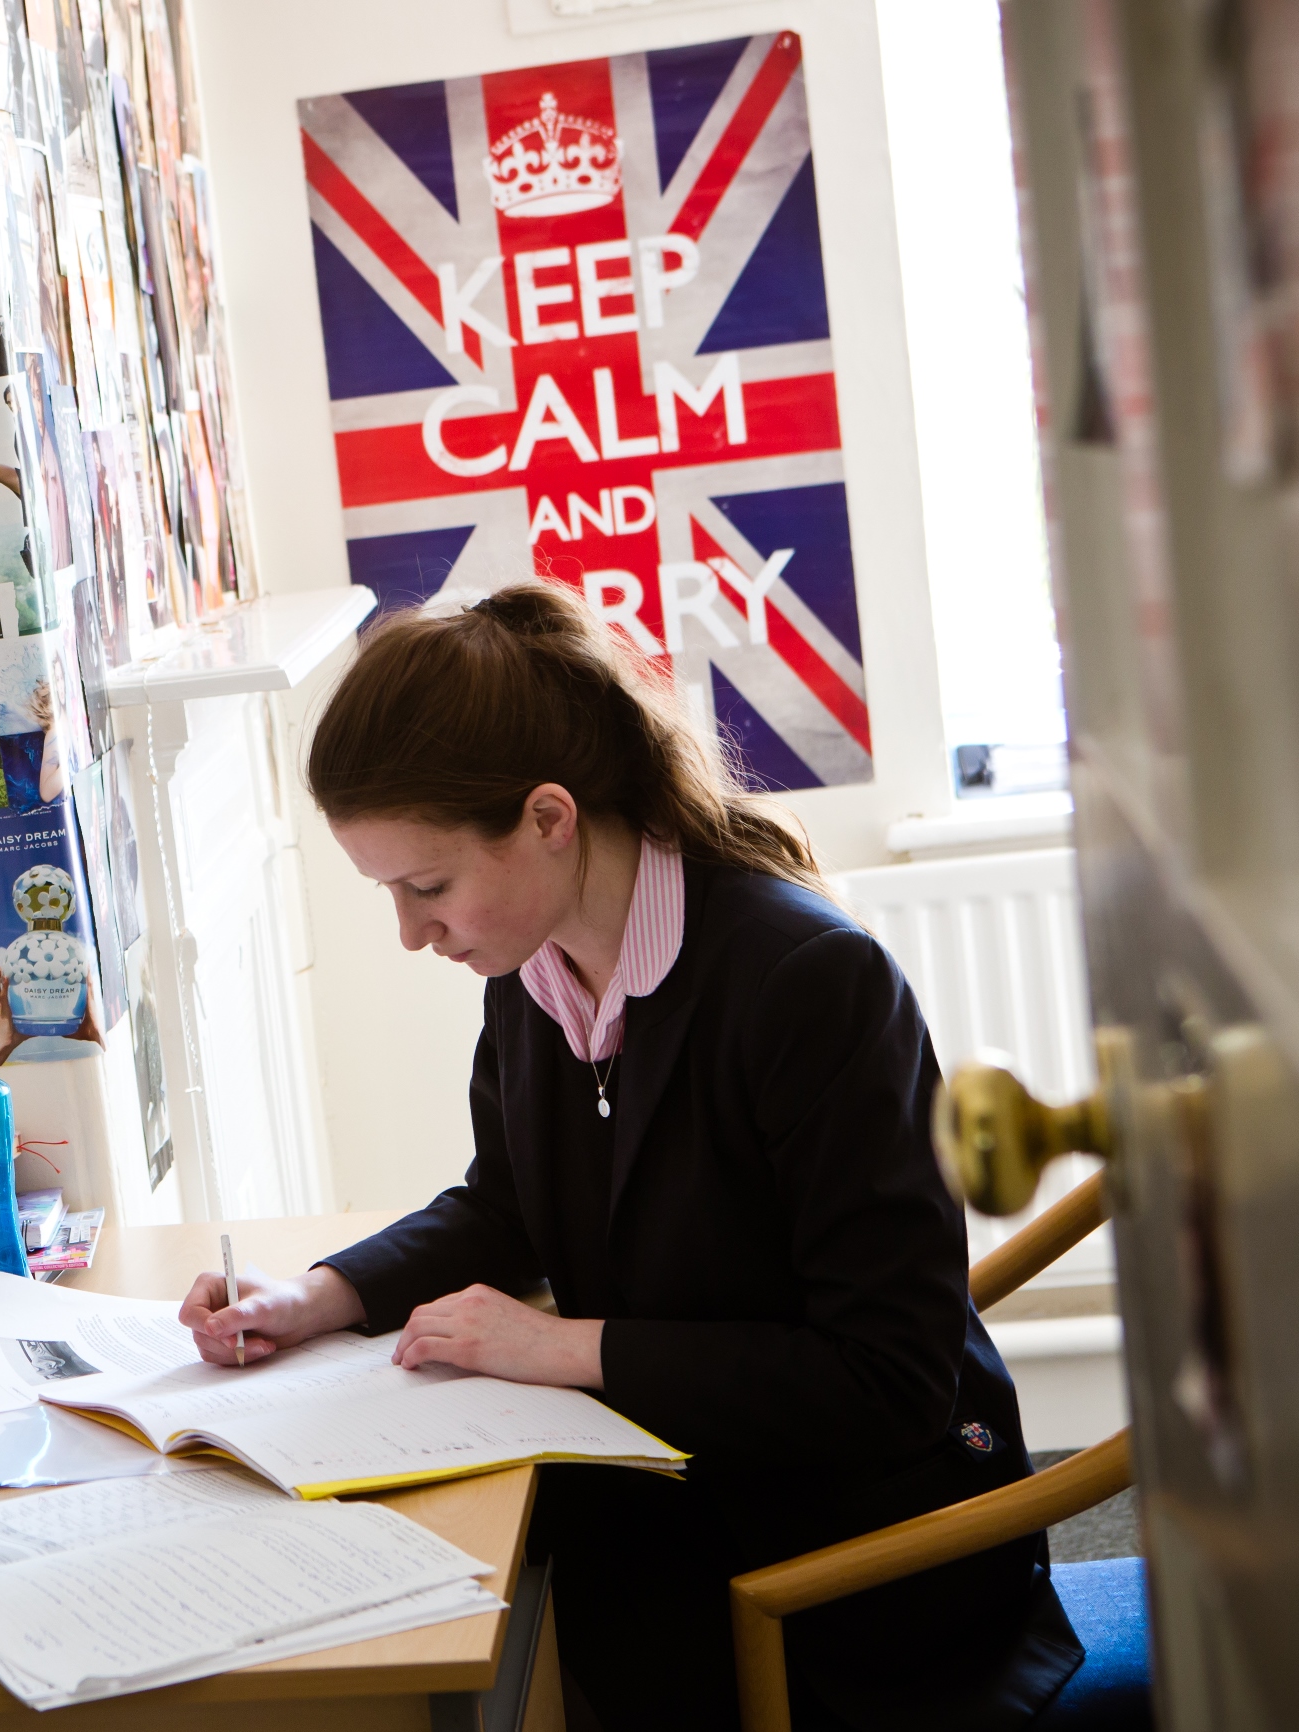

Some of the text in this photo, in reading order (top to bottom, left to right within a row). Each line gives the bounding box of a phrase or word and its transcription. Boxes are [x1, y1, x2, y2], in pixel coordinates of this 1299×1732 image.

[436, 232, 699, 355] KEEP
[421, 353, 749, 478] CALM
[525, 487, 658, 545] AND
[584, 548, 797, 661] RRY
[23, 840, 59, 850] JACOBS
[25, 828, 66, 842] DREAM
[49, 987, 75, 995] DREAM
